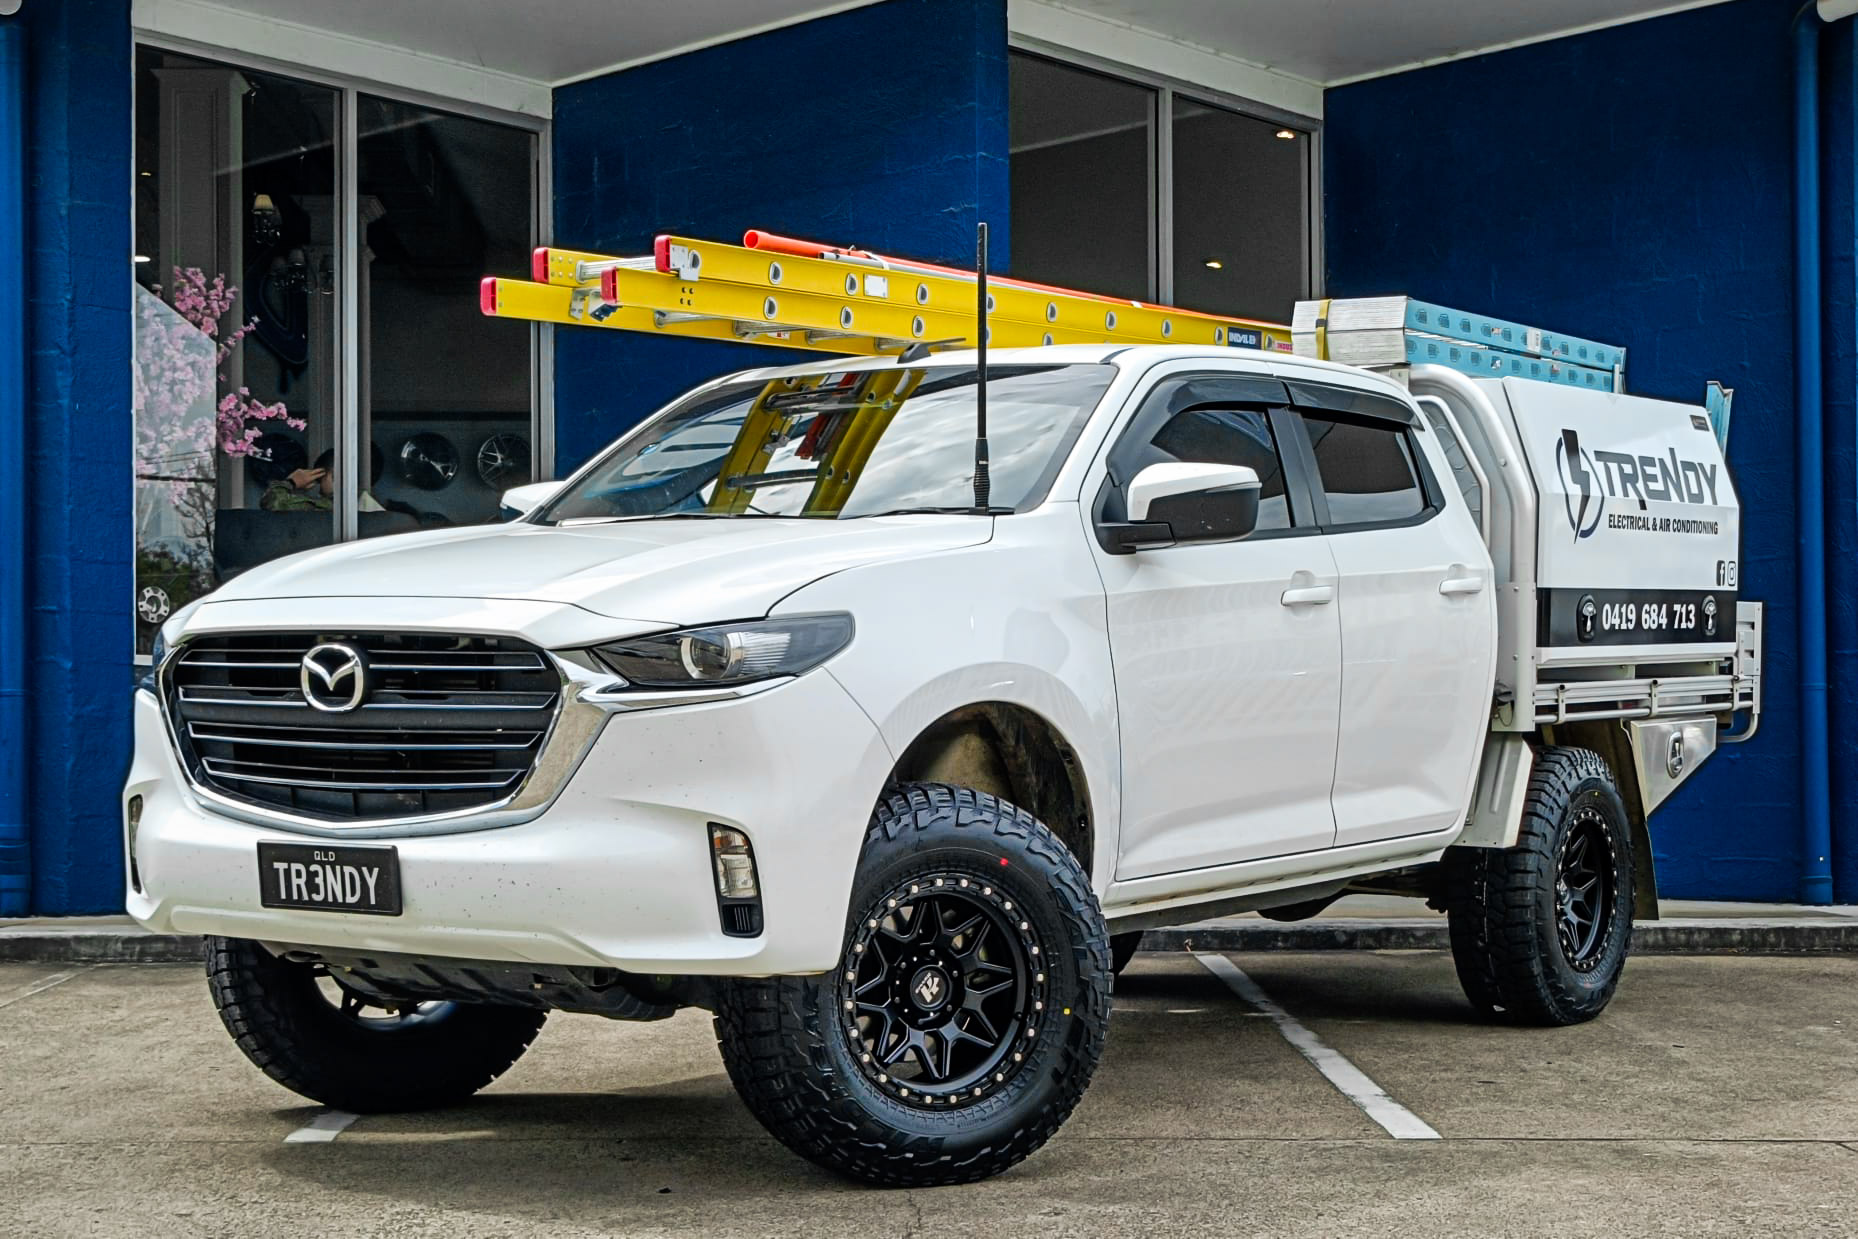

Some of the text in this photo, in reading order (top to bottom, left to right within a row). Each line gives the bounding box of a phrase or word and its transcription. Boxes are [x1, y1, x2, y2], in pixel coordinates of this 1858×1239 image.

[1594, 447, 1718, 510] TRENDY
[1608, 514, 1719, 535] ELECTRICAL & AIR CONDITIONING
[1602, 603, 1696, 630] 0419 684 713
[314, 851, 335, 861] QLD
[273, 862, 379, 905] TR3NDY
